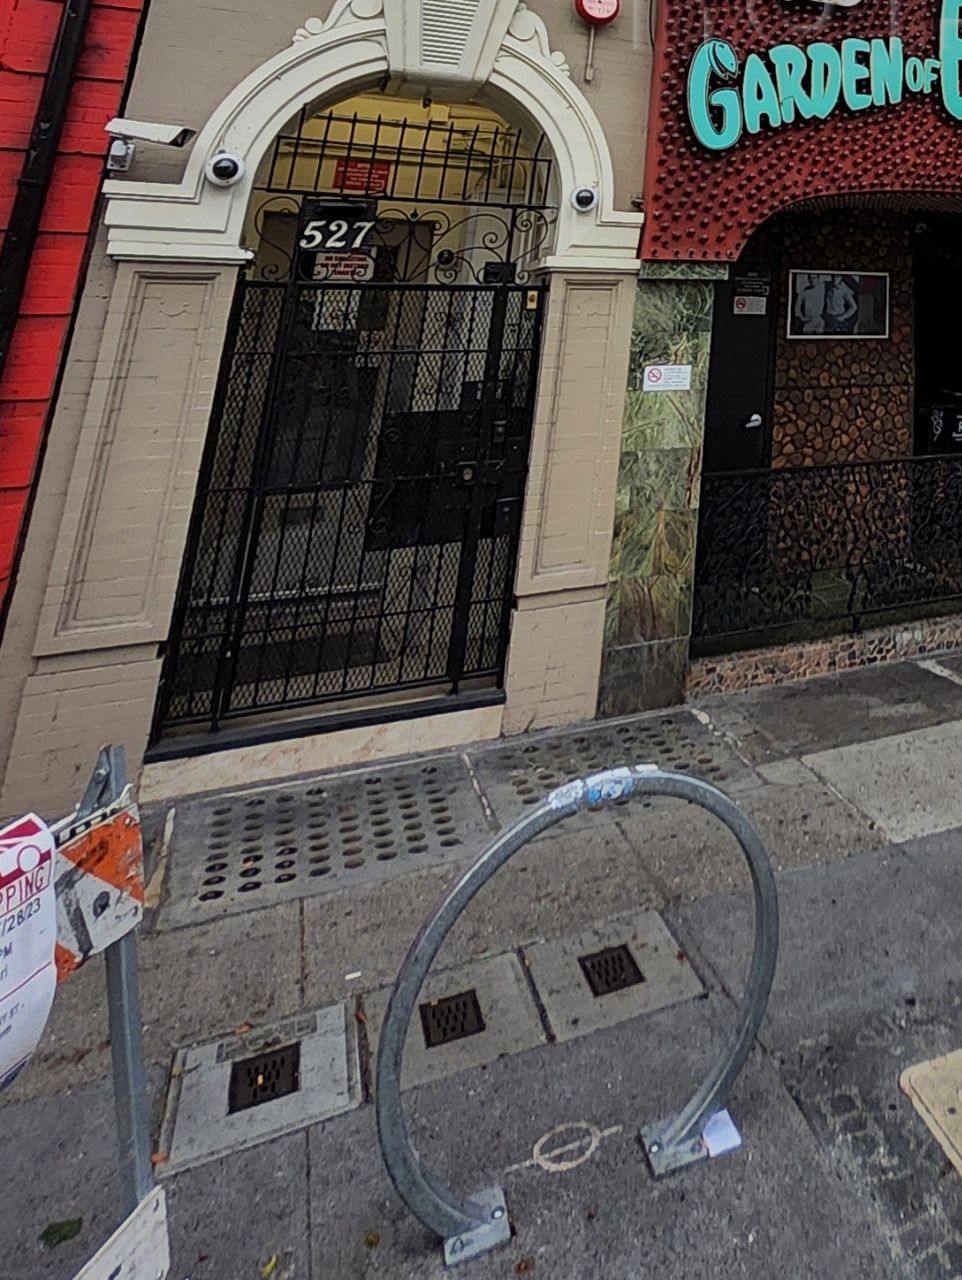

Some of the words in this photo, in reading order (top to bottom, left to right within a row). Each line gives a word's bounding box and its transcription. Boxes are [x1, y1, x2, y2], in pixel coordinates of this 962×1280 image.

[687, 36, 903, 151] GARDEN
[904, 56, 942, 93] OF
[299, 220, 376, 249] 527
[0, 896, 41, 937] /28/23
